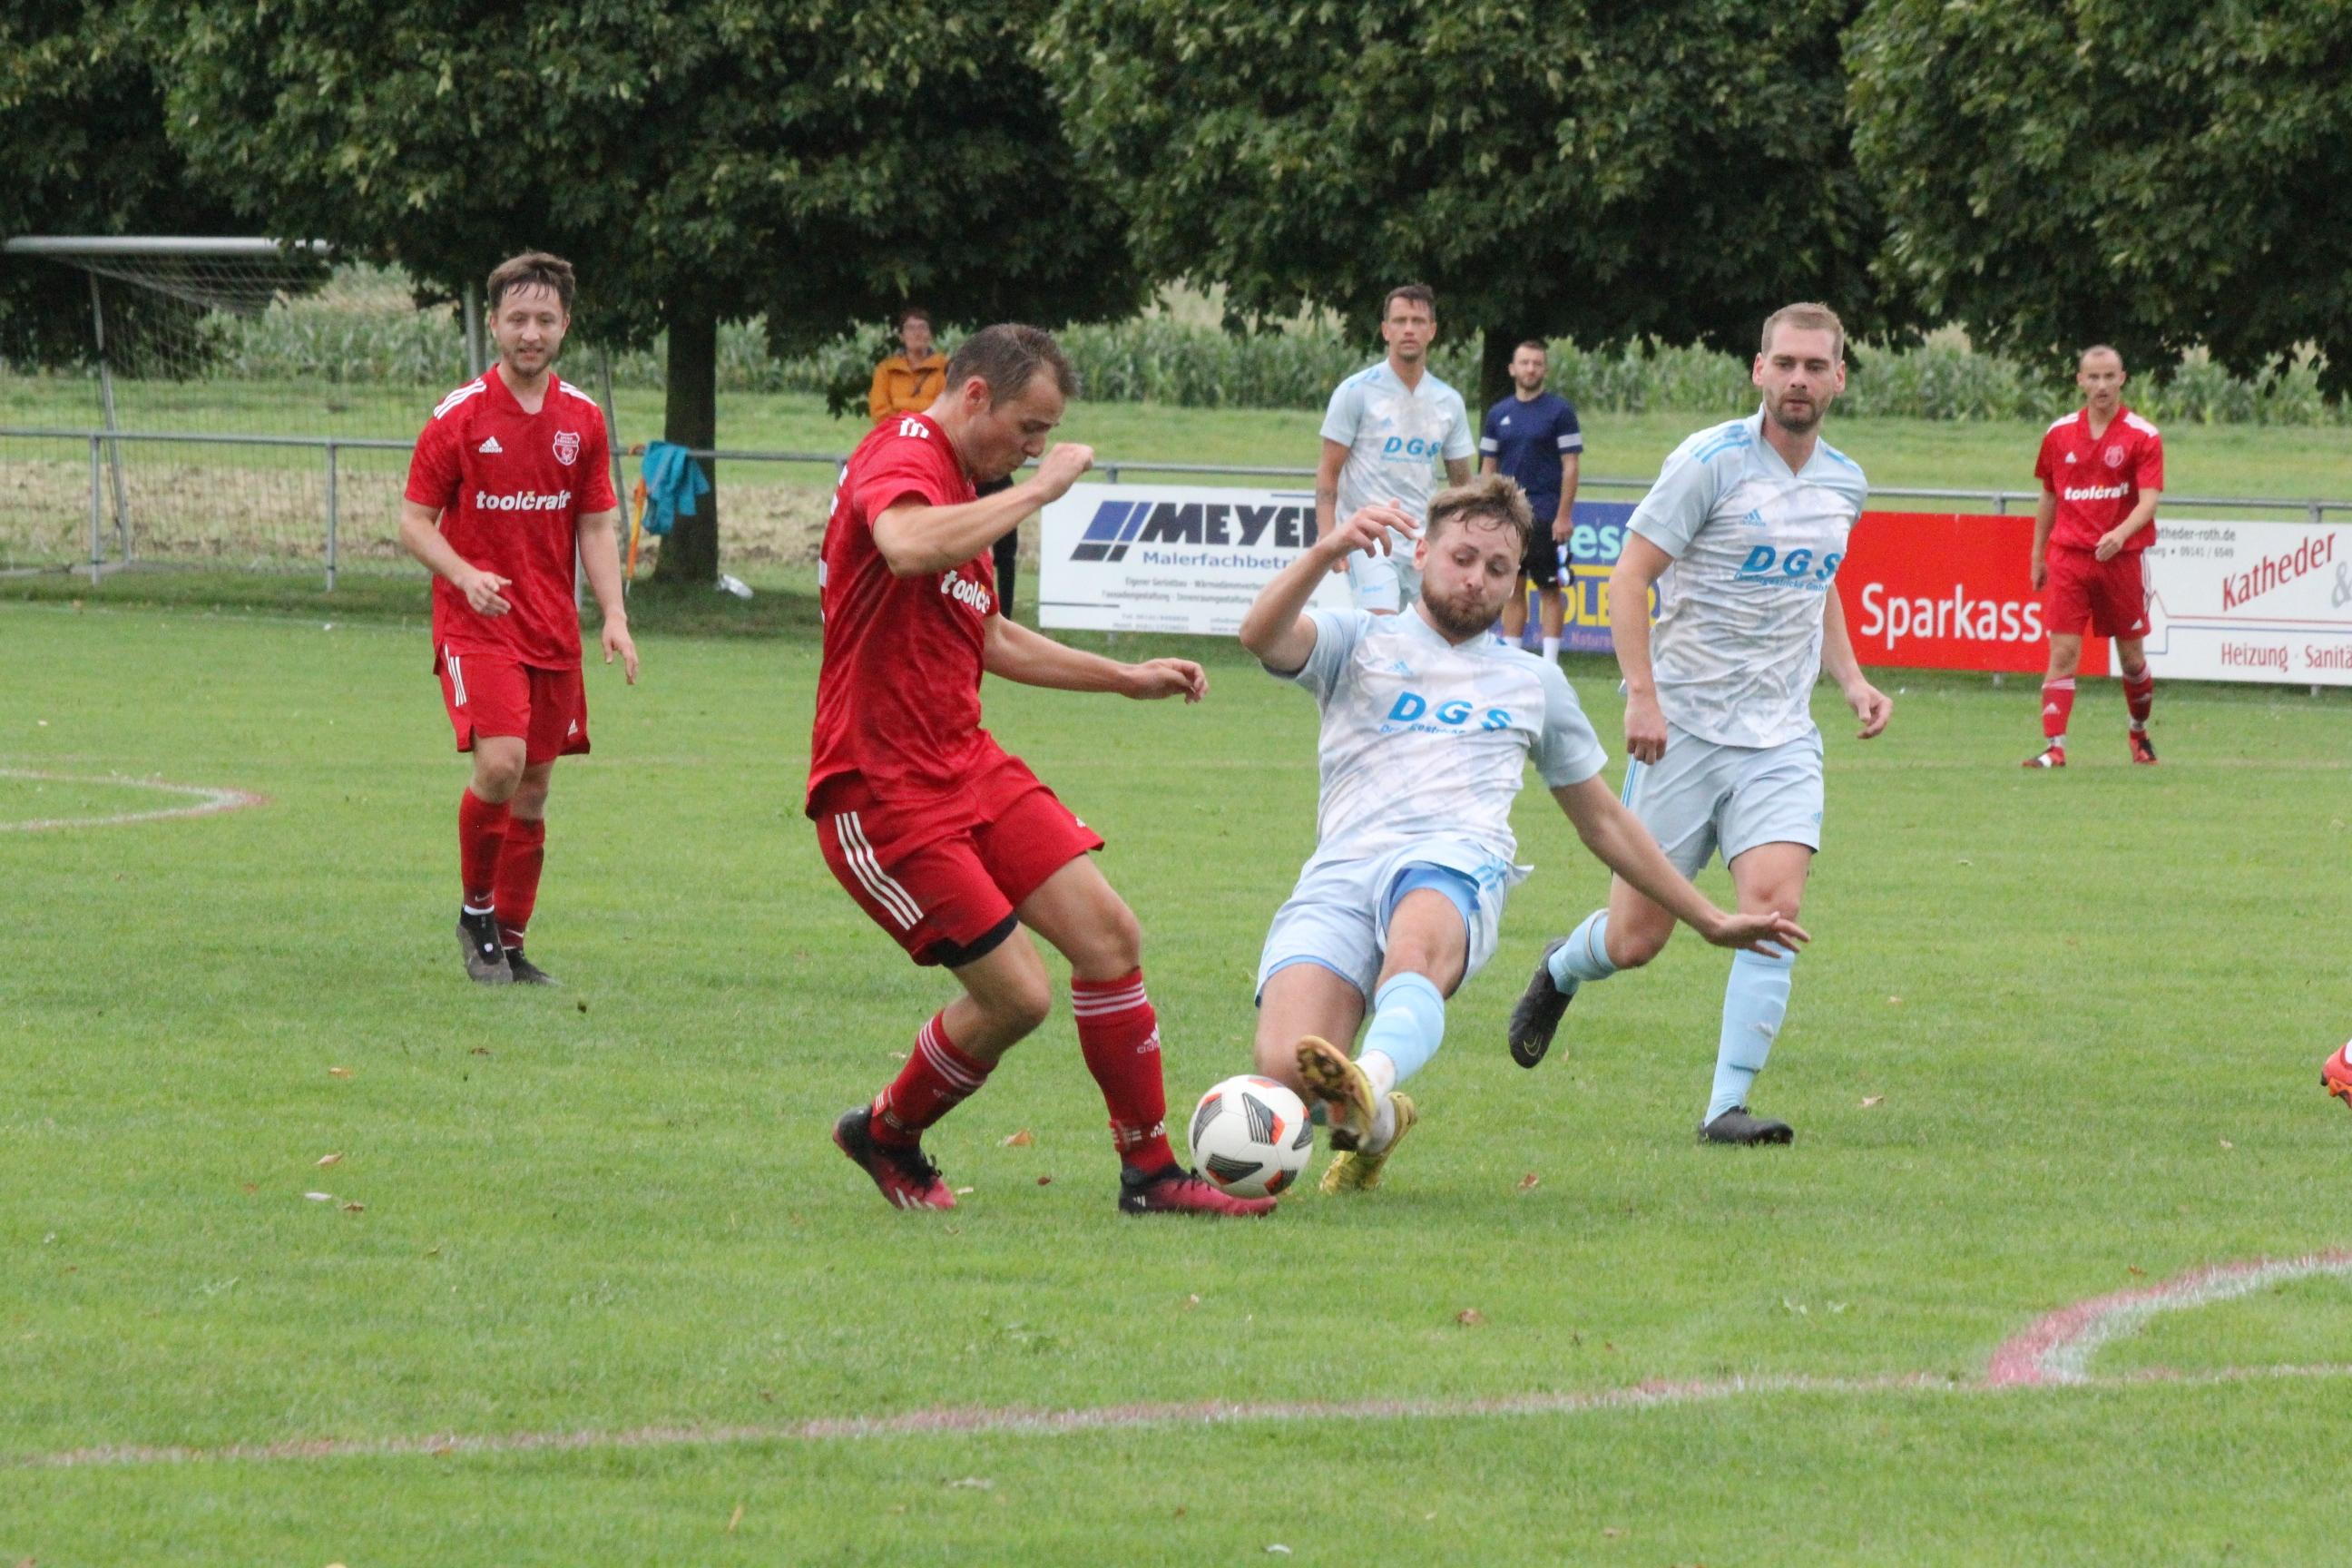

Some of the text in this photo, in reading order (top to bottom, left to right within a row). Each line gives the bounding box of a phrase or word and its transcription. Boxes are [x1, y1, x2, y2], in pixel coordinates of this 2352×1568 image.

[1383, 436, 1442, 457] DGS
[475, 490, 572, 511] toolcraft
[1740, 544, 1842, 581] DGS
[2222, 532, 2336, 612] Katheder
[1860, 582, 2053, 651] Sparkass
[2221, 642, 2288, 673] Heizung
[1387, 691, 1513, 733] DGS
